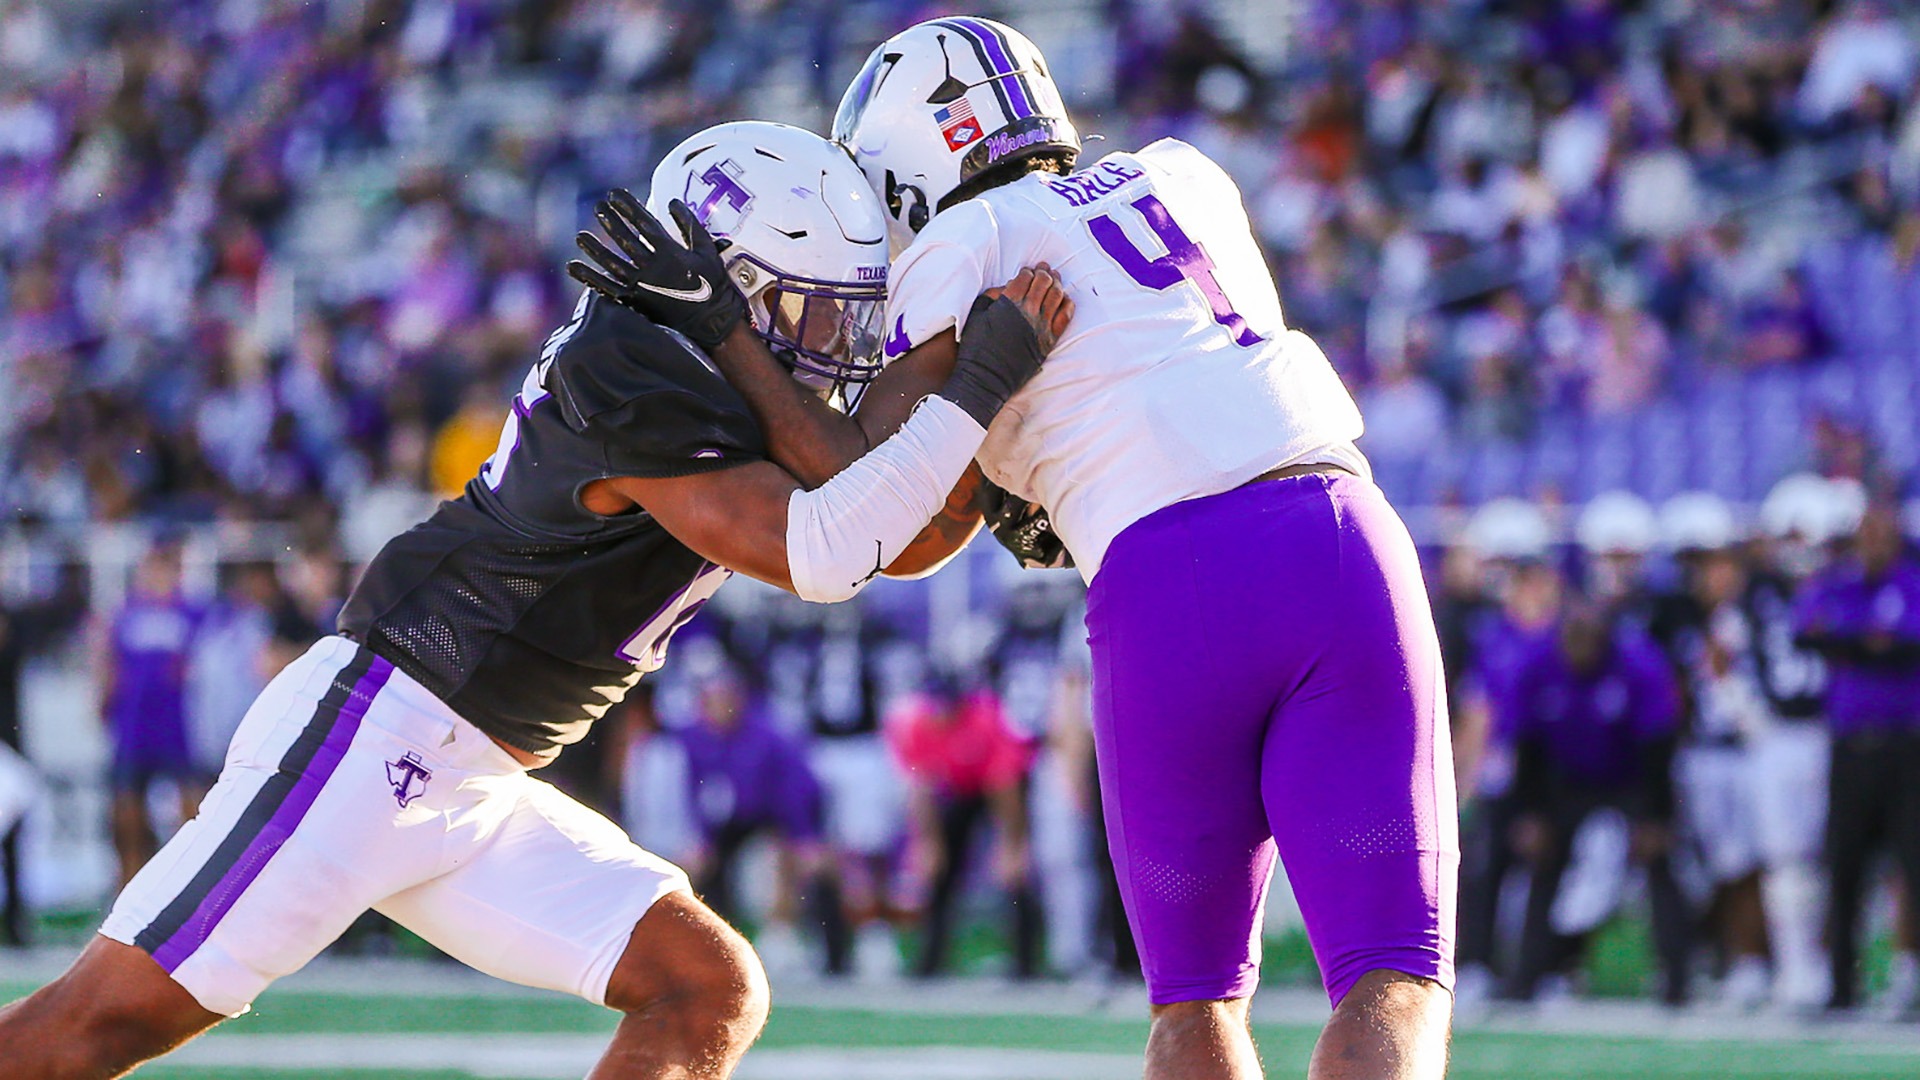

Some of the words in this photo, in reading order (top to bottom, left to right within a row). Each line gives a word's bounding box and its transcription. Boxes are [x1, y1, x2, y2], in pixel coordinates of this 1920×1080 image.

[700, 160, 756, 228] T
[1082, 193, 1267, 348] 4
[393, 754, 432, 803] T
